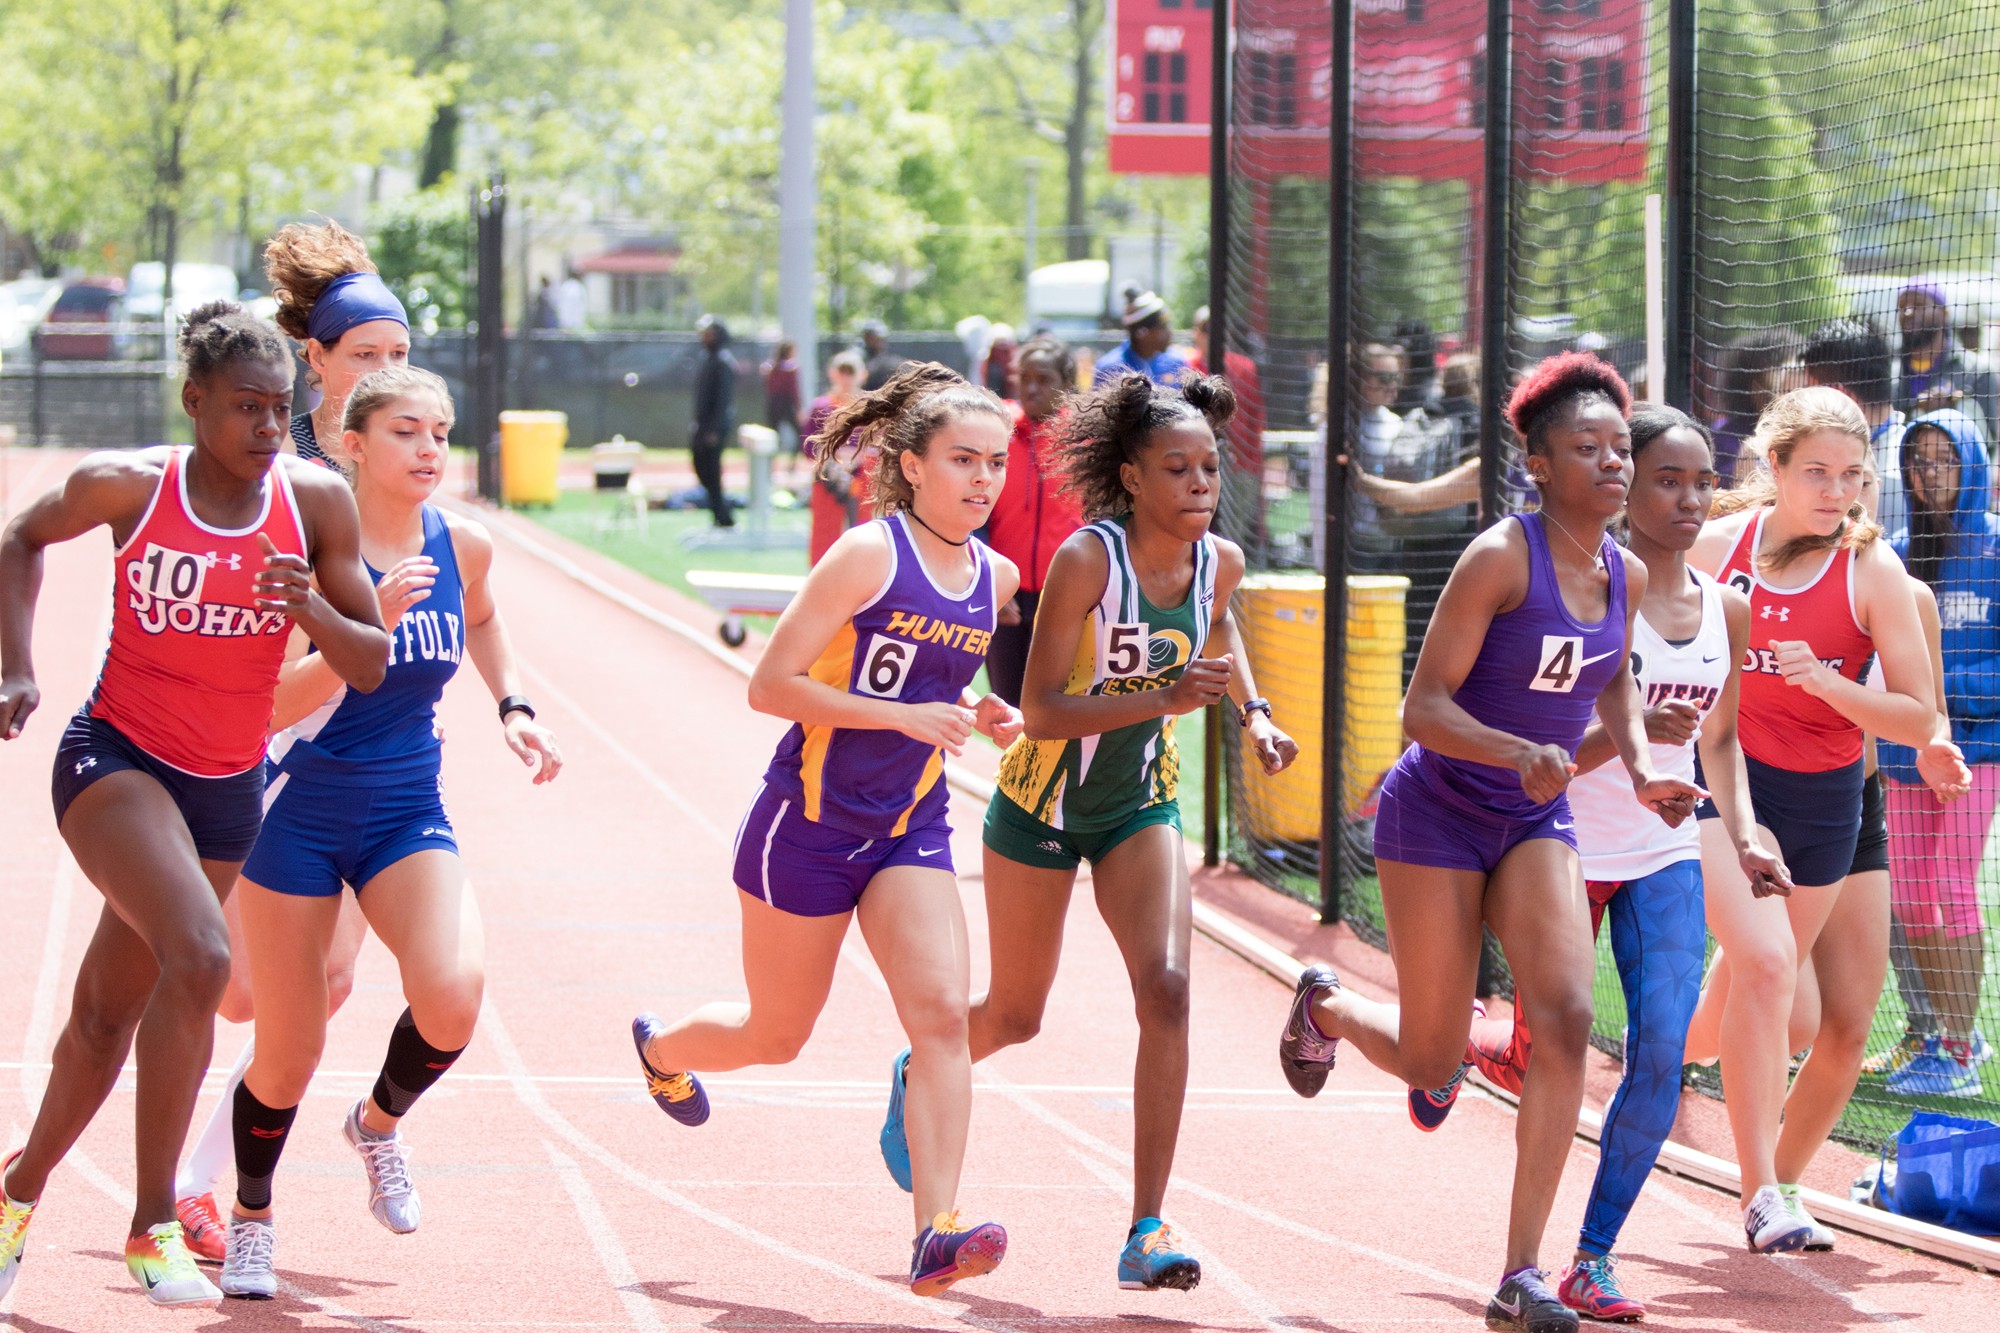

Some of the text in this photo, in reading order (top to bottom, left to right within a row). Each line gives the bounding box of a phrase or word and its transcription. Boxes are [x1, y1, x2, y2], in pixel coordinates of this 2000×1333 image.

[147, 550, 199, 599] 10
[388, 610, 461, 666] FFOLK
[885, 611, 992, 656] HUNTER
[1108, 627, 1140, 675] 5
[868, 642, 906, 693] 6
[1540, 641, 1574, 689] 4
[1646, 683, 1719, 711] EENS
